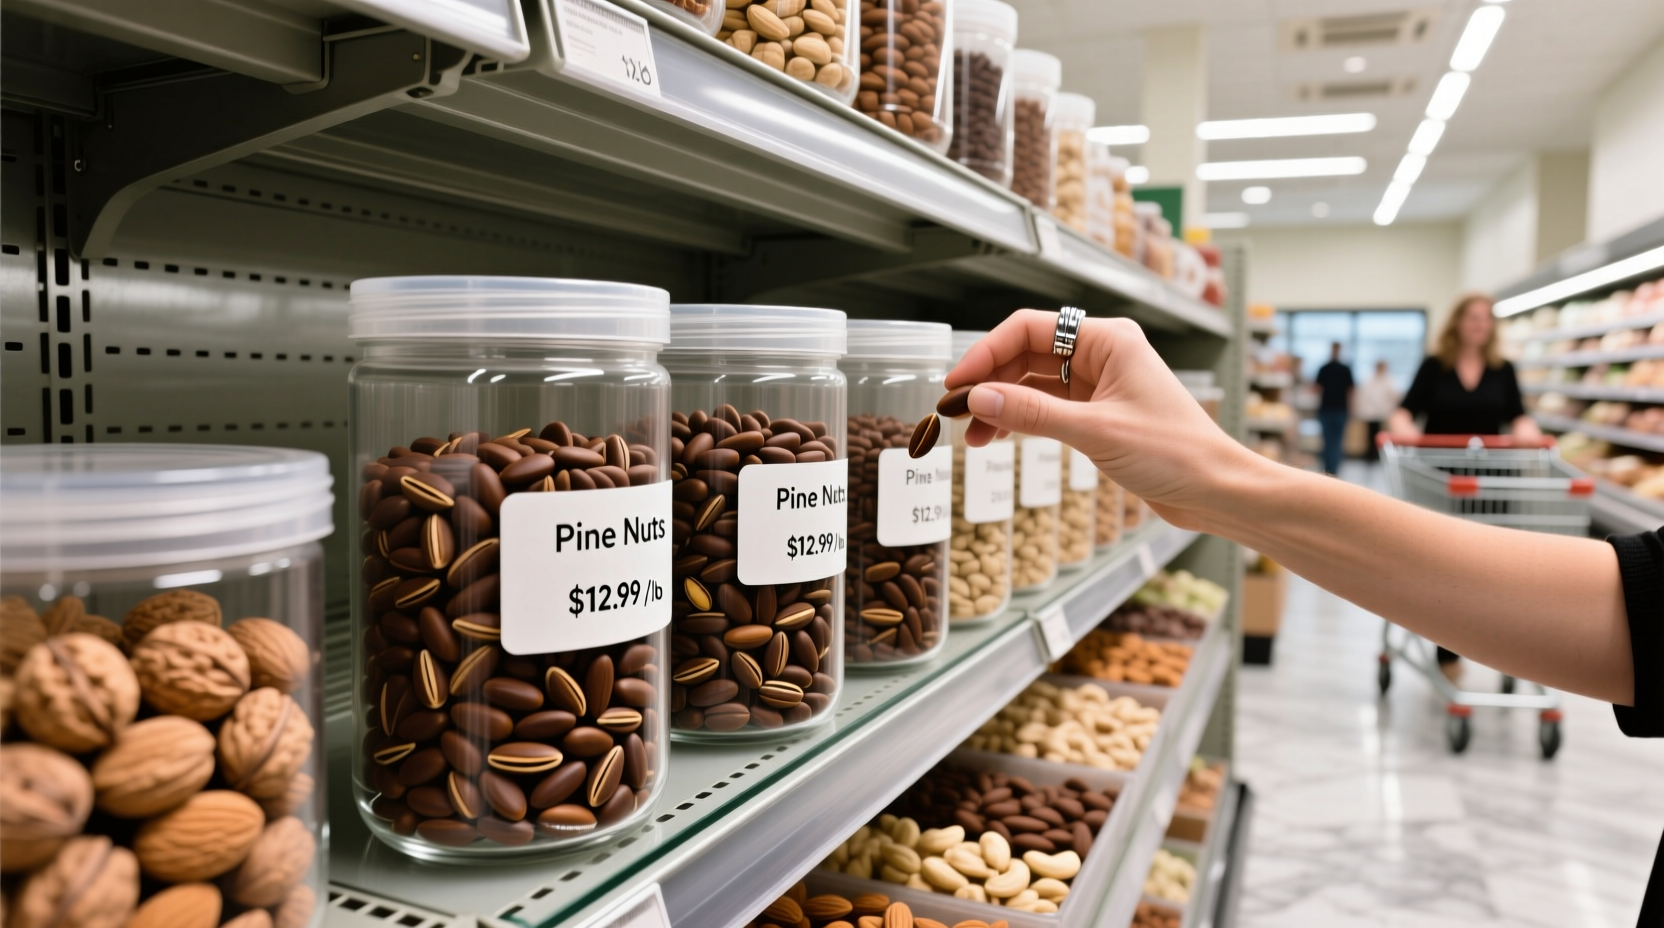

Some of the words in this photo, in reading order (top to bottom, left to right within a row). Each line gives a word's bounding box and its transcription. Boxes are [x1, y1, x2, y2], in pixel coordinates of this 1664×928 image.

[777, 486, 818, 510] Pine
[555, 522, 616, 552] Pine
[623, 516, 666, 546] Nuts
[569, 579, 641, 618] $12.99
[644, 579, 663, 607] /lb
